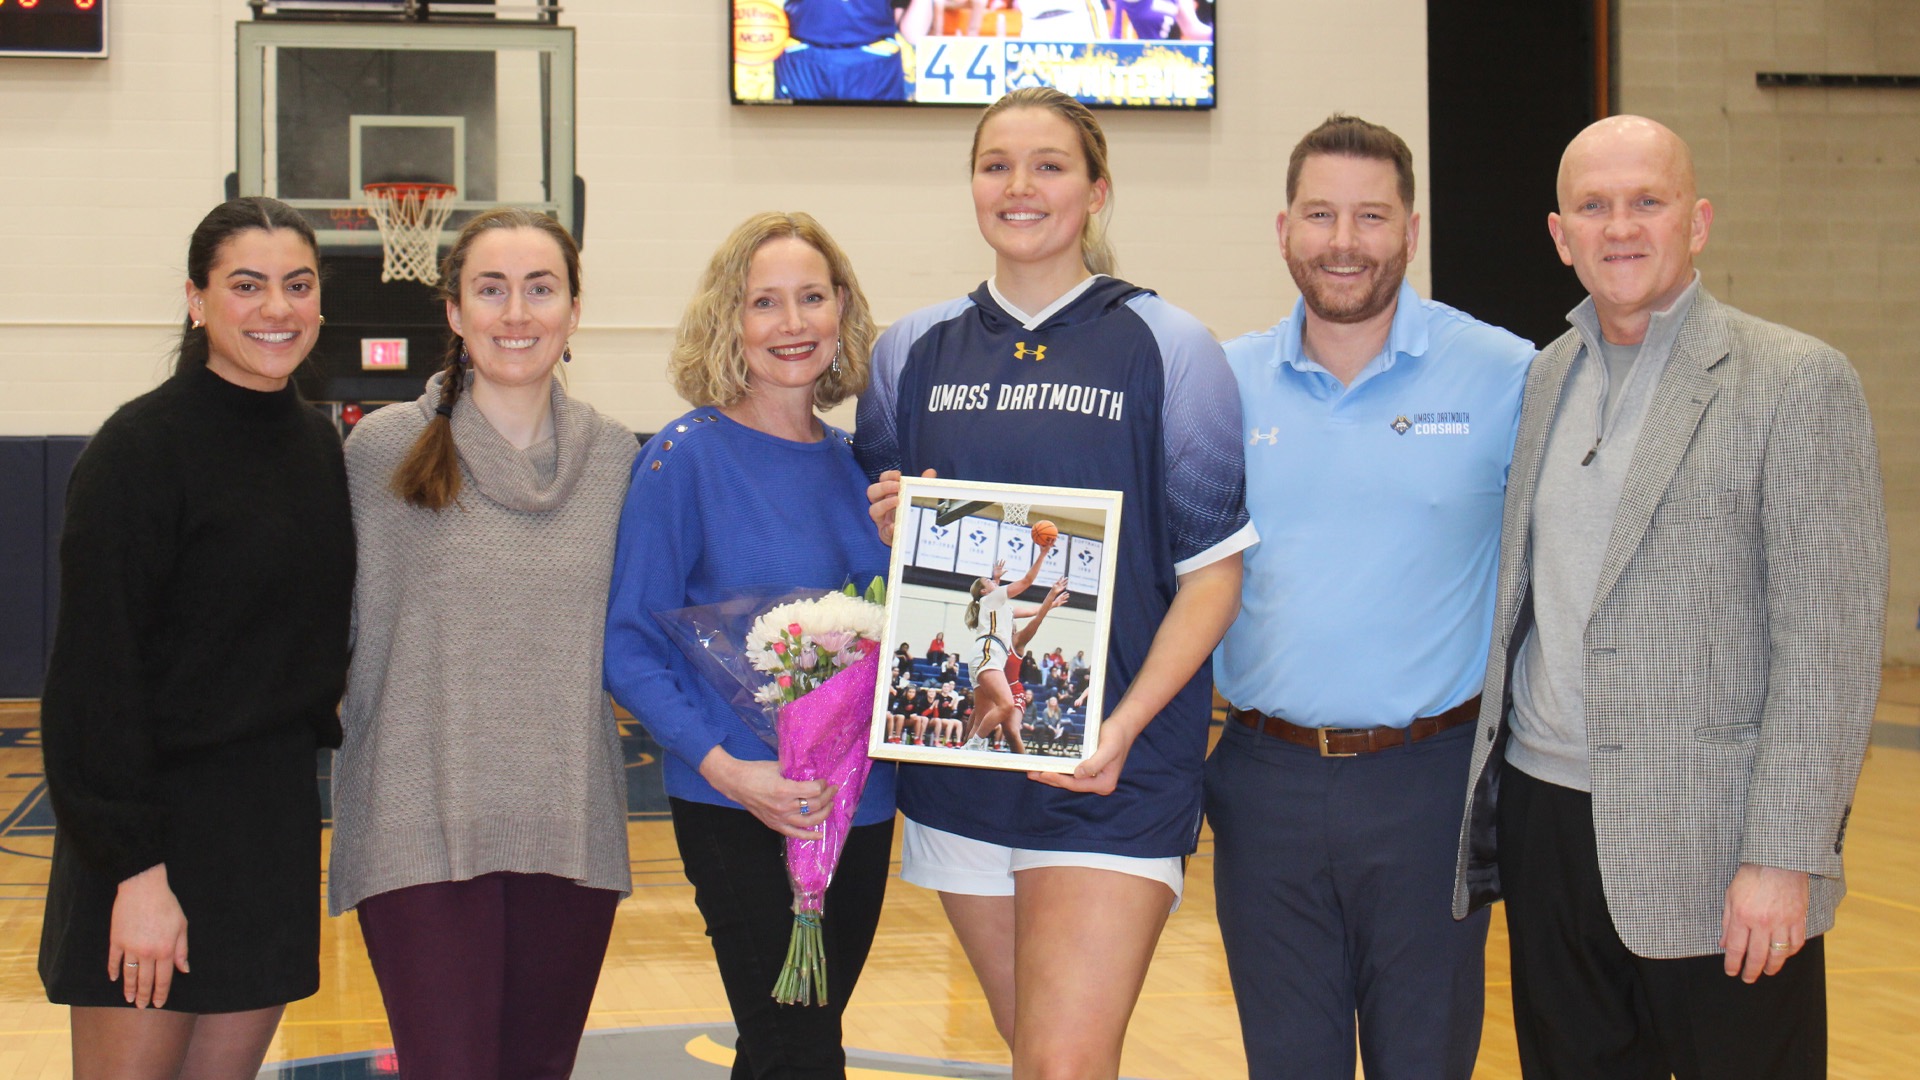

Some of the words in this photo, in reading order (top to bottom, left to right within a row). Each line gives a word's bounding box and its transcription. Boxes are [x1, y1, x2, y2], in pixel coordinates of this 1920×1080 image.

[924, 43, 996, 96] 44
[928, 383, 991, 412] UMASS
[996, 383, 1124, 421] DARTMOUTH
[1413, 413, 1435, 423] UMASS
[1437, 412, 1470, 423] DARTMOUTH
[1414, 423, 1470, 435] CORSAIRS
